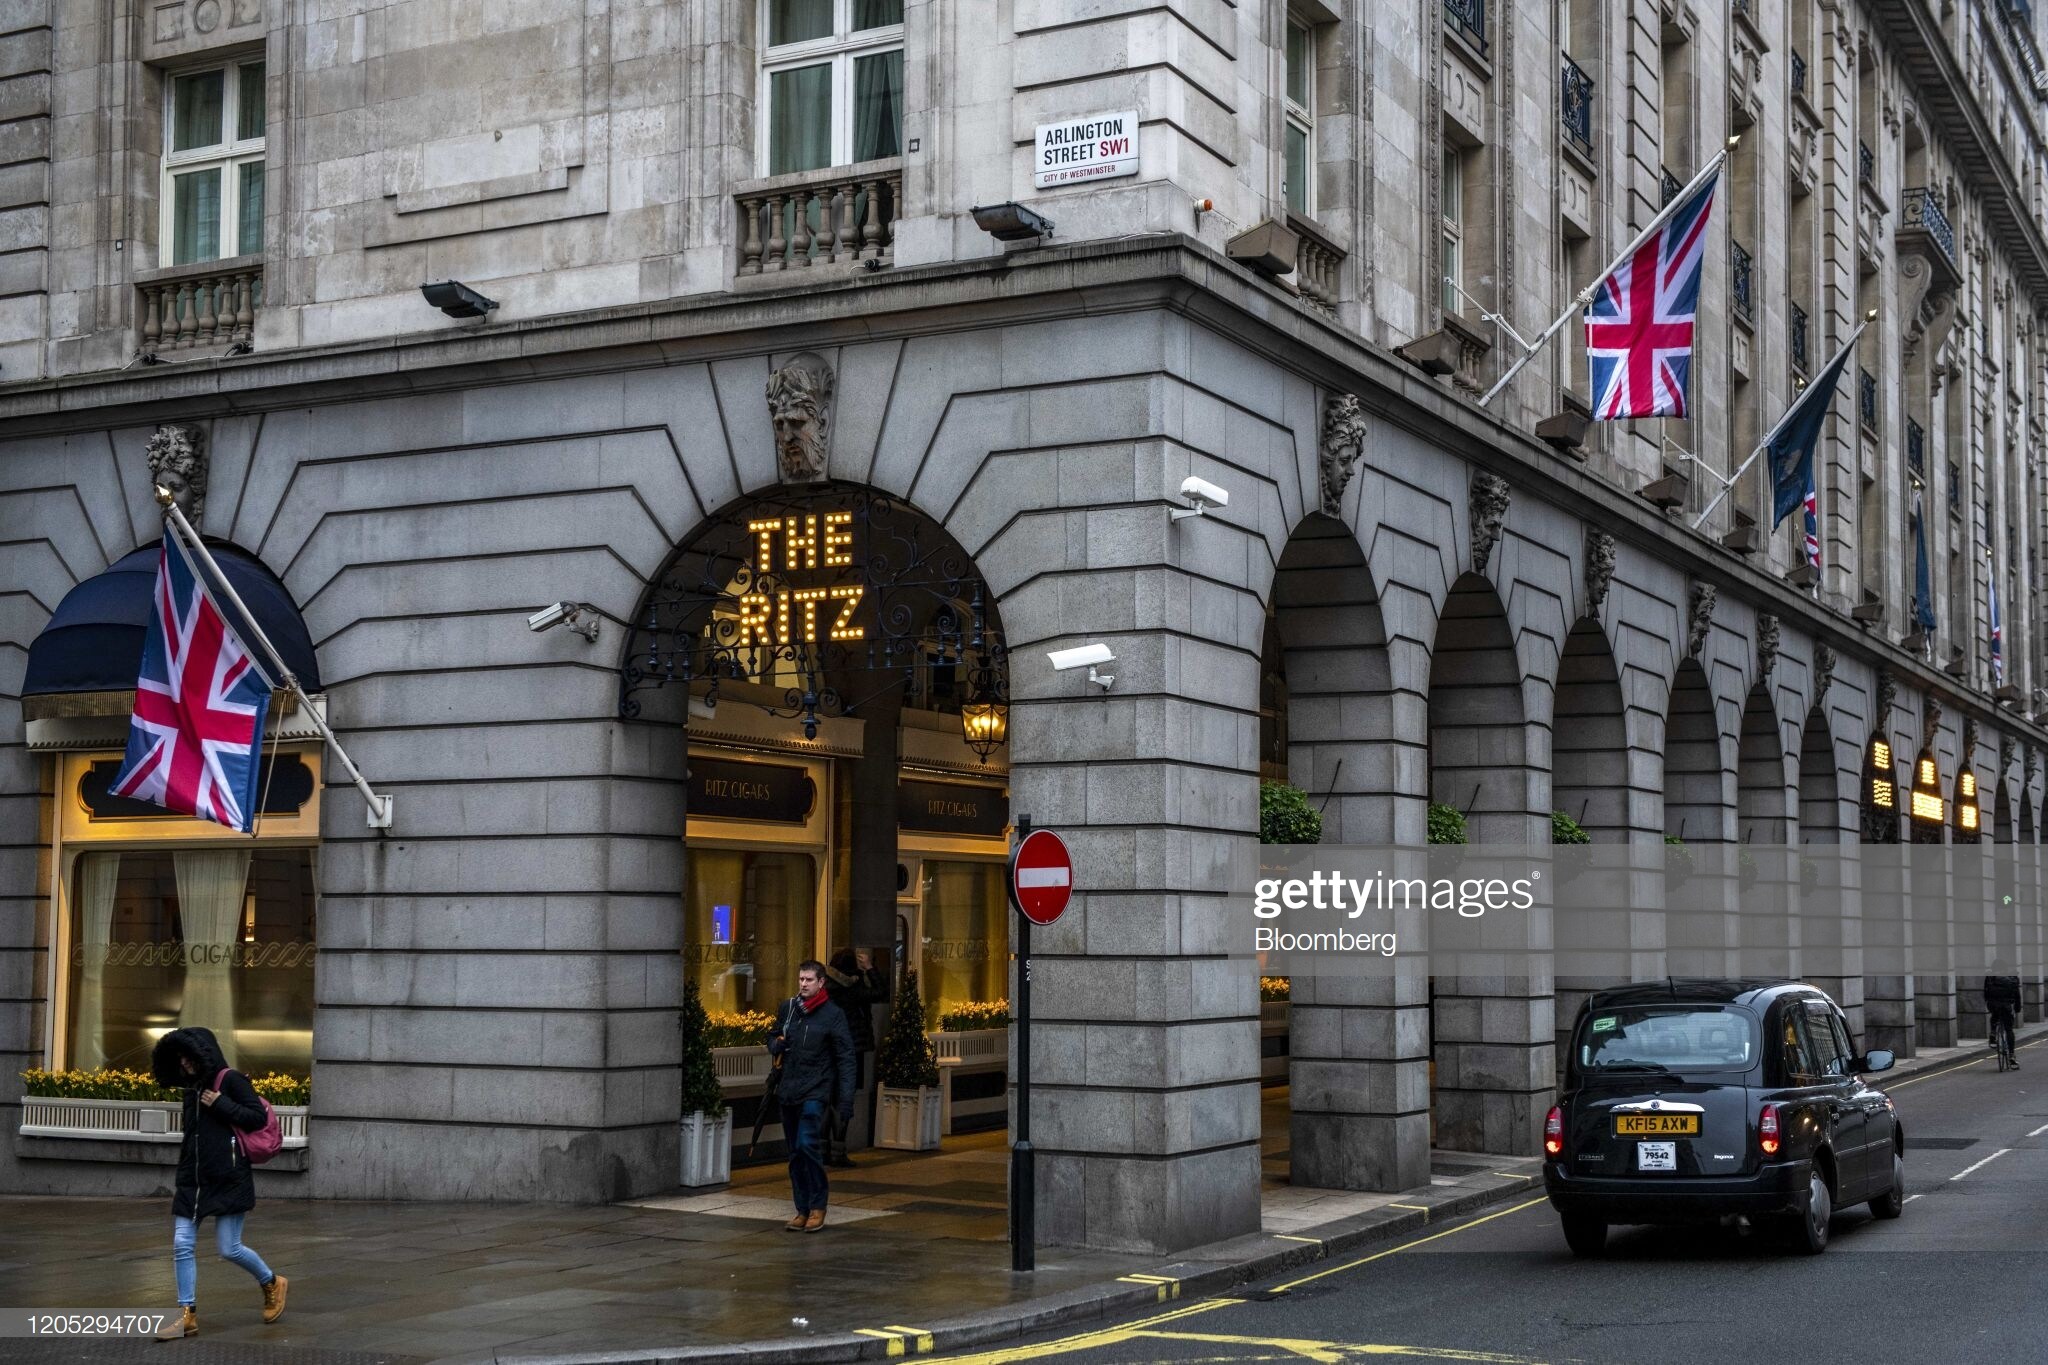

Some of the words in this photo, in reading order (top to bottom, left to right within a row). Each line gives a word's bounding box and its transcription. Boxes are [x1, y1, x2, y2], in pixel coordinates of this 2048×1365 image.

[1045, 119, 1123, 146] ARLINGTON
[1044, 143, 1096, 165] STREET
[1100, 137, 1129, 157] SW1
[1044, 173, 1058, 182] CITY
[1060, 172, 1068, 180] OF
[1070, 165, 1116, 178] WESTMINSTER
[749, 511, 852, 572] THE
[740, 584, 864, 647] RITZ
[705, 779, 728, 796] RITZ
[731, 781, 770, 801] CIGARS
[928, 800, 945, 815] RITZ
[947, 802, 977, 818] CIGARS
[190, 944, 244, 964] CIGA
[1626, 1117, 1657, 1130] KF15
[1661, 1117, 1688, 1130] AXW
[1645, 1151, 1669, 1160] 79542
